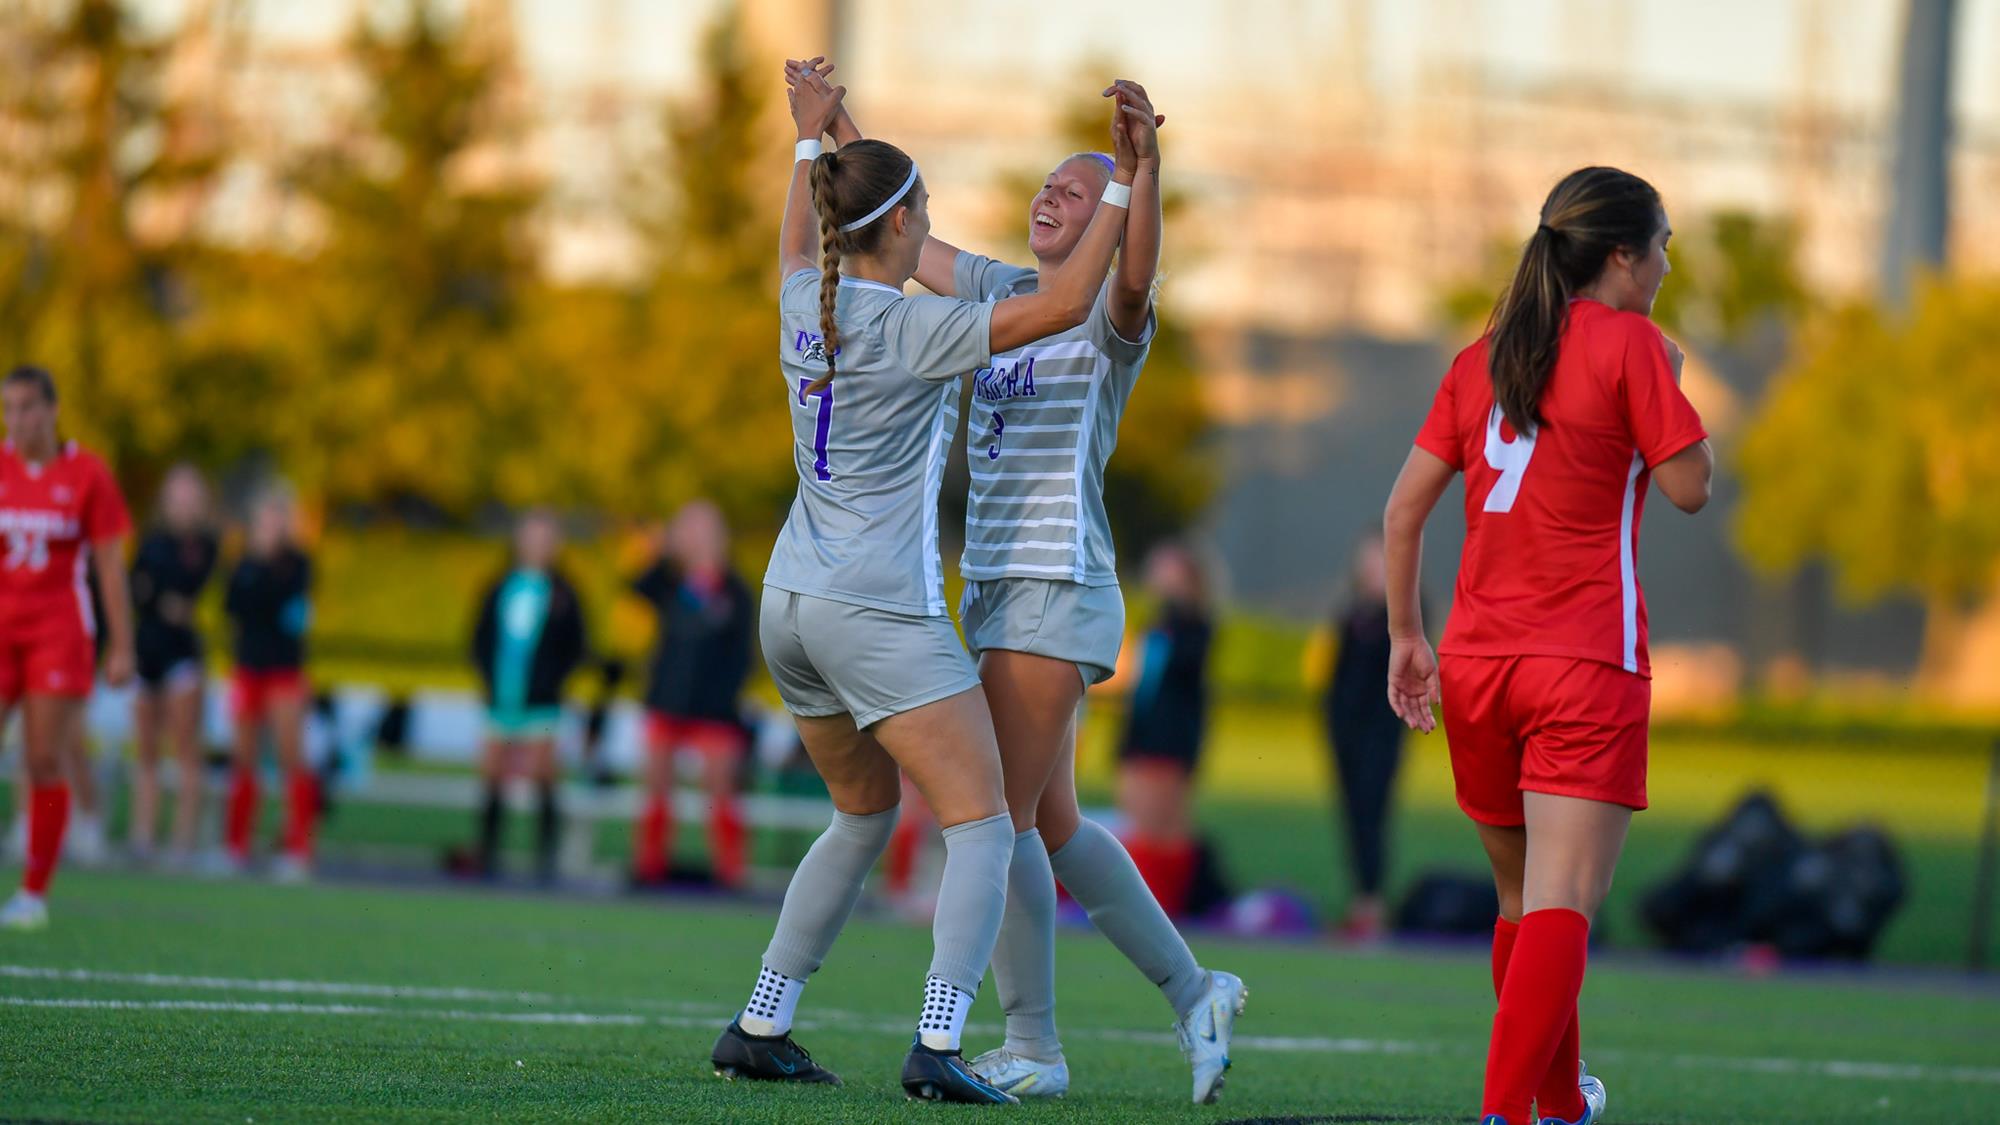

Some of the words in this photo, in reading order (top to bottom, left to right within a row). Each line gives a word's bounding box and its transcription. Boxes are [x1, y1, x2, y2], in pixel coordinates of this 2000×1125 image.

[798, 376, 835, 483] 7
[988, 410, 1005, 461] 3
[1482, 400, 1539, 513] 9
